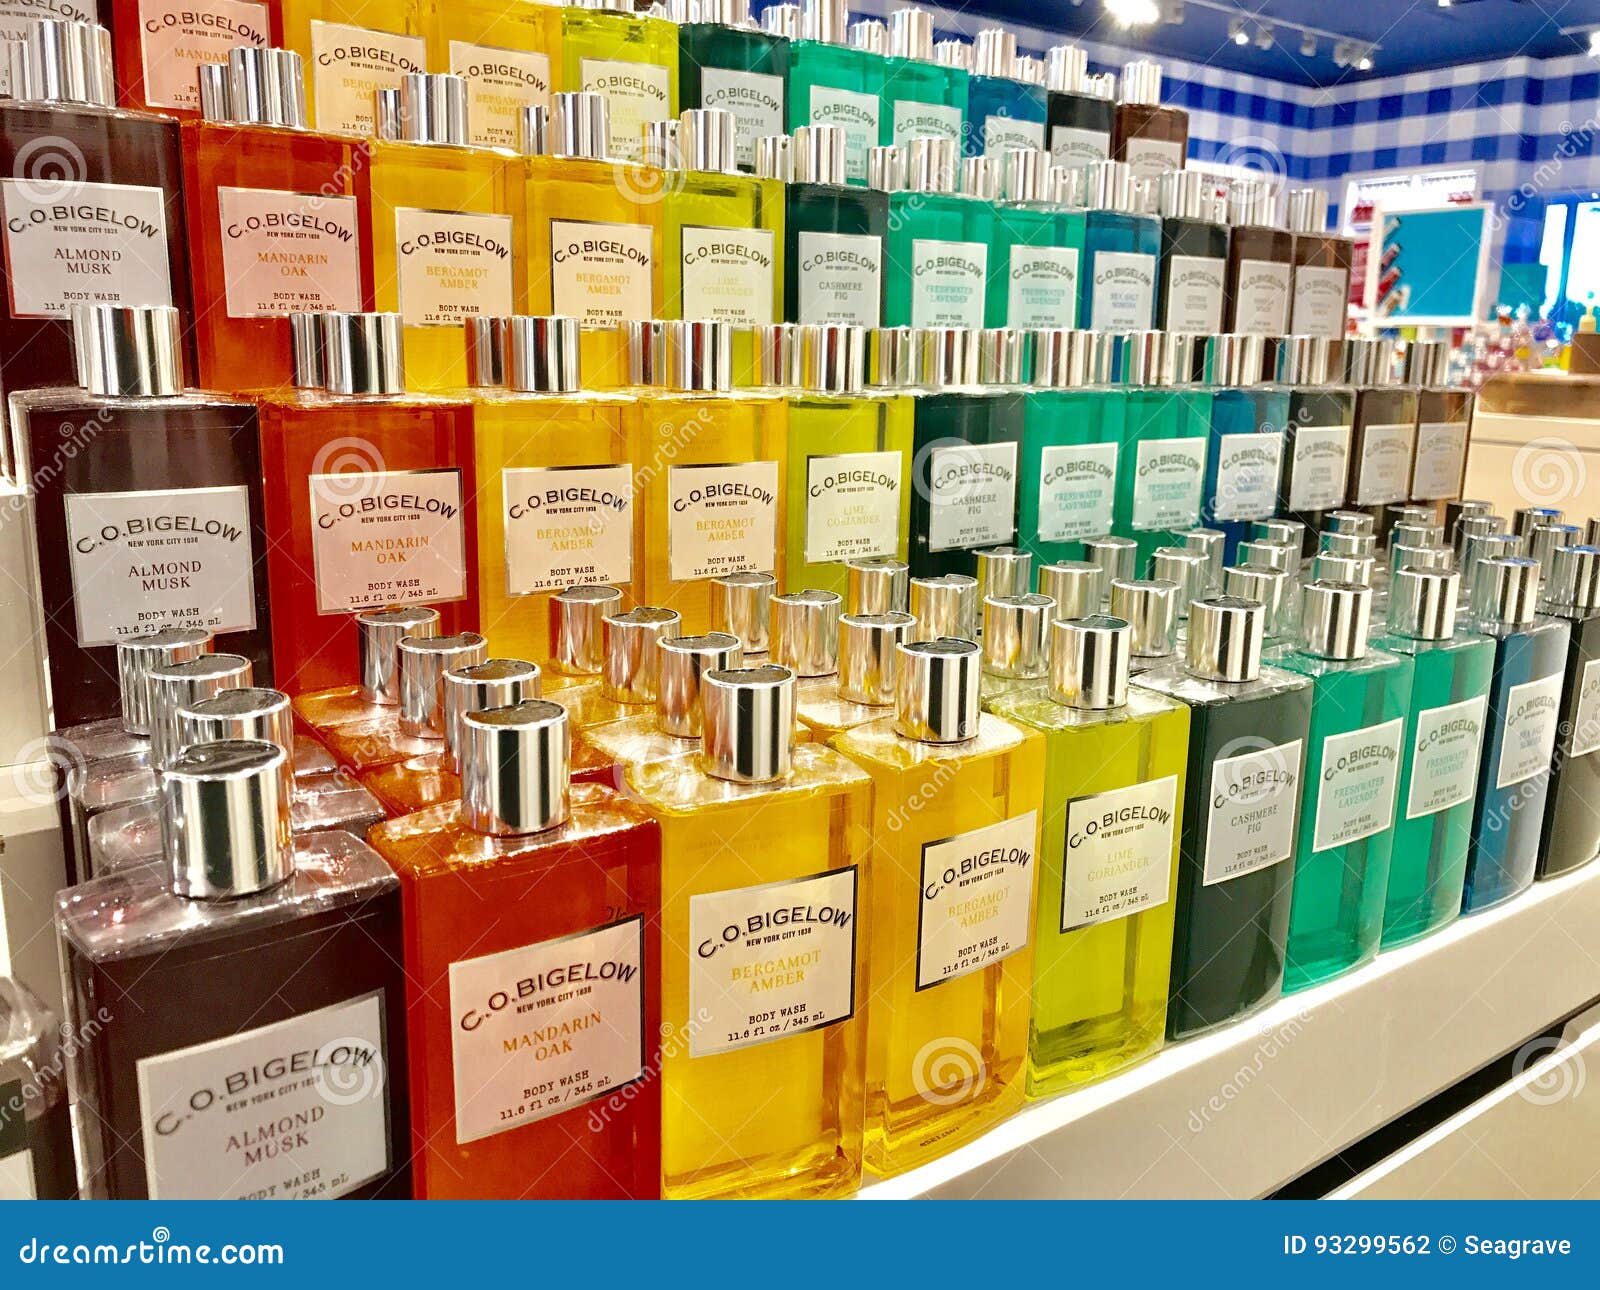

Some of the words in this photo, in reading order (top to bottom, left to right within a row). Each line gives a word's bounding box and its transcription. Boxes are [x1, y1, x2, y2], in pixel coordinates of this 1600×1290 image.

[146, 12, 265, 45] C.O.BIGELOW
[175, 48, 229, 62] MANDAR
[456, 64, 546, 91] .O.BIGELOW
[706, 87, 780, 112] C.O.BIGELOW
[9, 205, 159, 238] C.O.BIGELOW
[228, 213, 352, 242] C.O.BIGELOW
[54, 248, 122, 261] ALMOND
[401, 232, 508, 259] C.O.BIGELOW
[554, 241, 648, 266] C.O.BIGELOW
[685, 244, 770, 268] C.O.BIGELOW
[67, 263, 112, 275] MUSK
[258, 253, 328, 265] MANDARIN
[803, 251, 878, 273] C.O.BIGELOW
[915, 257, 983, 279] C.O.BIGELOW
[281, 266, 308, 277] OAK
[426, 266, 488, 278] BERGAMOT
[440, 279, 478, 289] AMBER
[819, 282, 863, 291] CASHMERE
[64, 292, 90, 300] BODY
[95, 292, 120, 300] WASH
[835, 292, 848, 300] FIG
[811, 471, 897, 497] C.O.BIGELOW
[509, 488, 627, 519] C.O.BIGELOW
[674, 483, 773, 512] C.O.BIGELOW
[319, 495, 457, 529] C.O.BIGELOW
[76, 516, 242, 554] C.O.BIGELOW
[696, 517, 755, 531] BERGAMOT
[146, 539, 164, 547] YORK
[352, 536, 429, 552] MANDARIN
[551, 539, 594, 551] AMBER
[708, 530, 745, 542] AMBER
[128, 560, 201, 578] ALMOND
[377, 552, 406, 564] OAK
[550, 568, 570, 577] BODY
[575, 566, 595, 574] WASH
[142, 577, 191, 591] MUSK
[368, 582, 392, 590] BODY
[396, 579, 420, 587] WASH
[408, 590, 423, 598] 345
[138, 610, 167, 621] BODY
[172, 608, 199, 617] WASH
[1324, 745, 1397, 781] C.O.BIGELOW
[1231, 804, 1279, 827] CASHMERE
[1070, 806, 1171, 849] C.O.BIGELOW
[1247, 822, 1261, 834] FIG
[925, 848, 1030, 900] C.O.BIGELOW
[959, 878, 970, 888] NEW
[948, 886, 1010, 917] BERGAMOT
[1099, 892, 1117, 904] BODY
[1120, 887, 1138, 897] WASH
[960, 905, 999, 929] AMBER
[697, 906, 851, 959] C.O.BIGELOW
[746, 938, 761, 947] NEW
[764, 934, 780, 943] YORK
[782, 931, 796, 940] CITY
[958, 945, 977, 958] BODY
[980, 936, 998, 950] WASH
[731, 950, 821, 981] BERGAMOT
[750, 970, 805, 993] AMBER
[461, 961, 636, 1031] C.O.BIGELOW
[517, 1002, 533, 1014] NEW
[537, 997, 555, 1009] YORK
[558, 992, 573, 1004] CITY
[728, 1030, 749, 1041] 11.6
[753, 1026, 765, 1036] fl
[769, 1024, 780, 1032] oz
[793, 1016, 808, 1027] 345
[813, 1011, 825, 1022] mL
[749, 1012, 776, 1025] BODY
[780, 1004, 806, 1018] WASH
[503, 1011, 601, 1054] MANDARIN
[535, 1039, 573, 1062] OAK
[155, 1046, 378, 1136] C.O.BIGELOW
[523, 1082, 554, 1099] BODY
[560, 1070, 589, 1087] WASH
[500, 1106, 525, 1120] 11.6
[530, 1098, 543, 1111] fl
[547, 1095, 560, 1105] oz
[574, 1083, 593, 1096] 345
[597, 1076, 611, 1088] mL
[225, 1105, 325, 1153] ALMOND
[244, 1131, 309, 1167] MUSK
[238, 1185, 276, 1200] ODY
[283, 1168, 320, 1191] WASH
